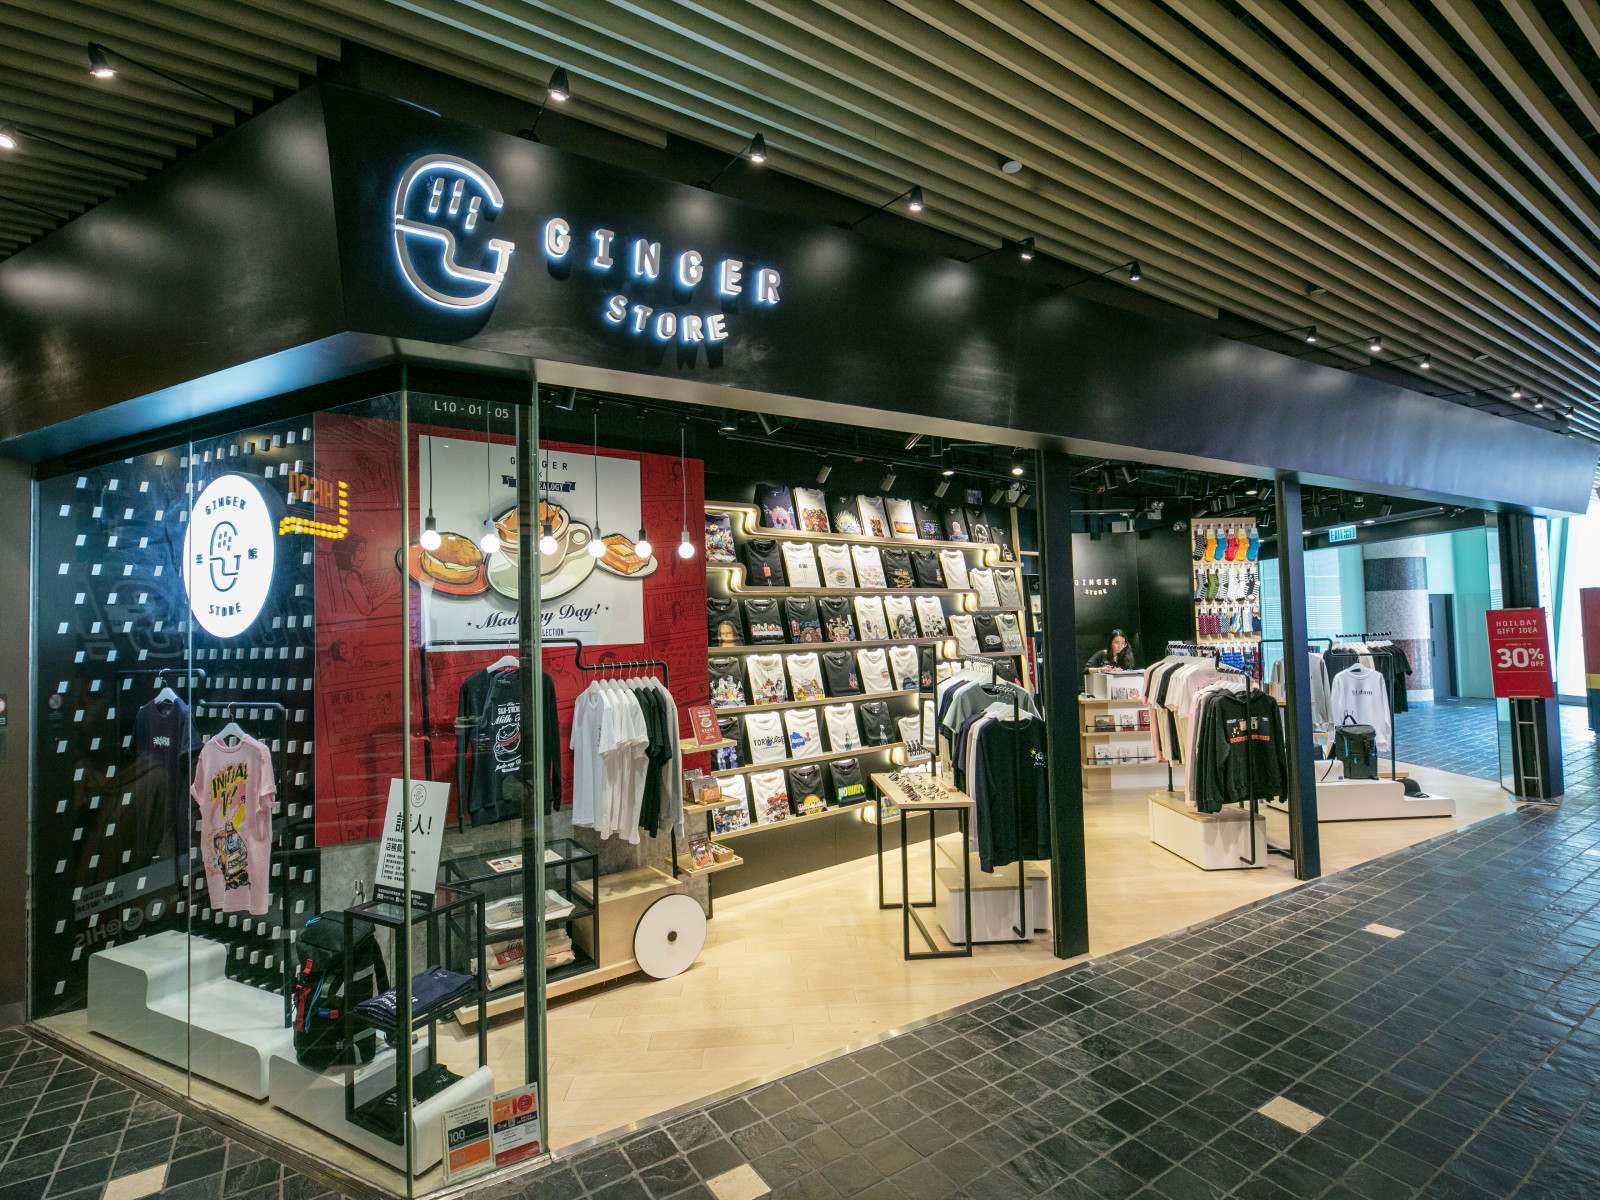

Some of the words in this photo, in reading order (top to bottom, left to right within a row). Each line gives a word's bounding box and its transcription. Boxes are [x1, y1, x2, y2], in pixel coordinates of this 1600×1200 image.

[545, 217, 782, 304] GINGER
[606, 294, 729, 341] STORE
[434, 400, 457, 413] L10
[510, 456, 568, 471] GGER
[205, 496, 247, 515] GINGER
[208, 602, 242, 617] STORE
[475, 609, 520, 629] Mad
[559, 603, 600, 622] Day!
[1497, 627, 1515, 635] GIFT
[1496, 647, 1544, 668] 30%
